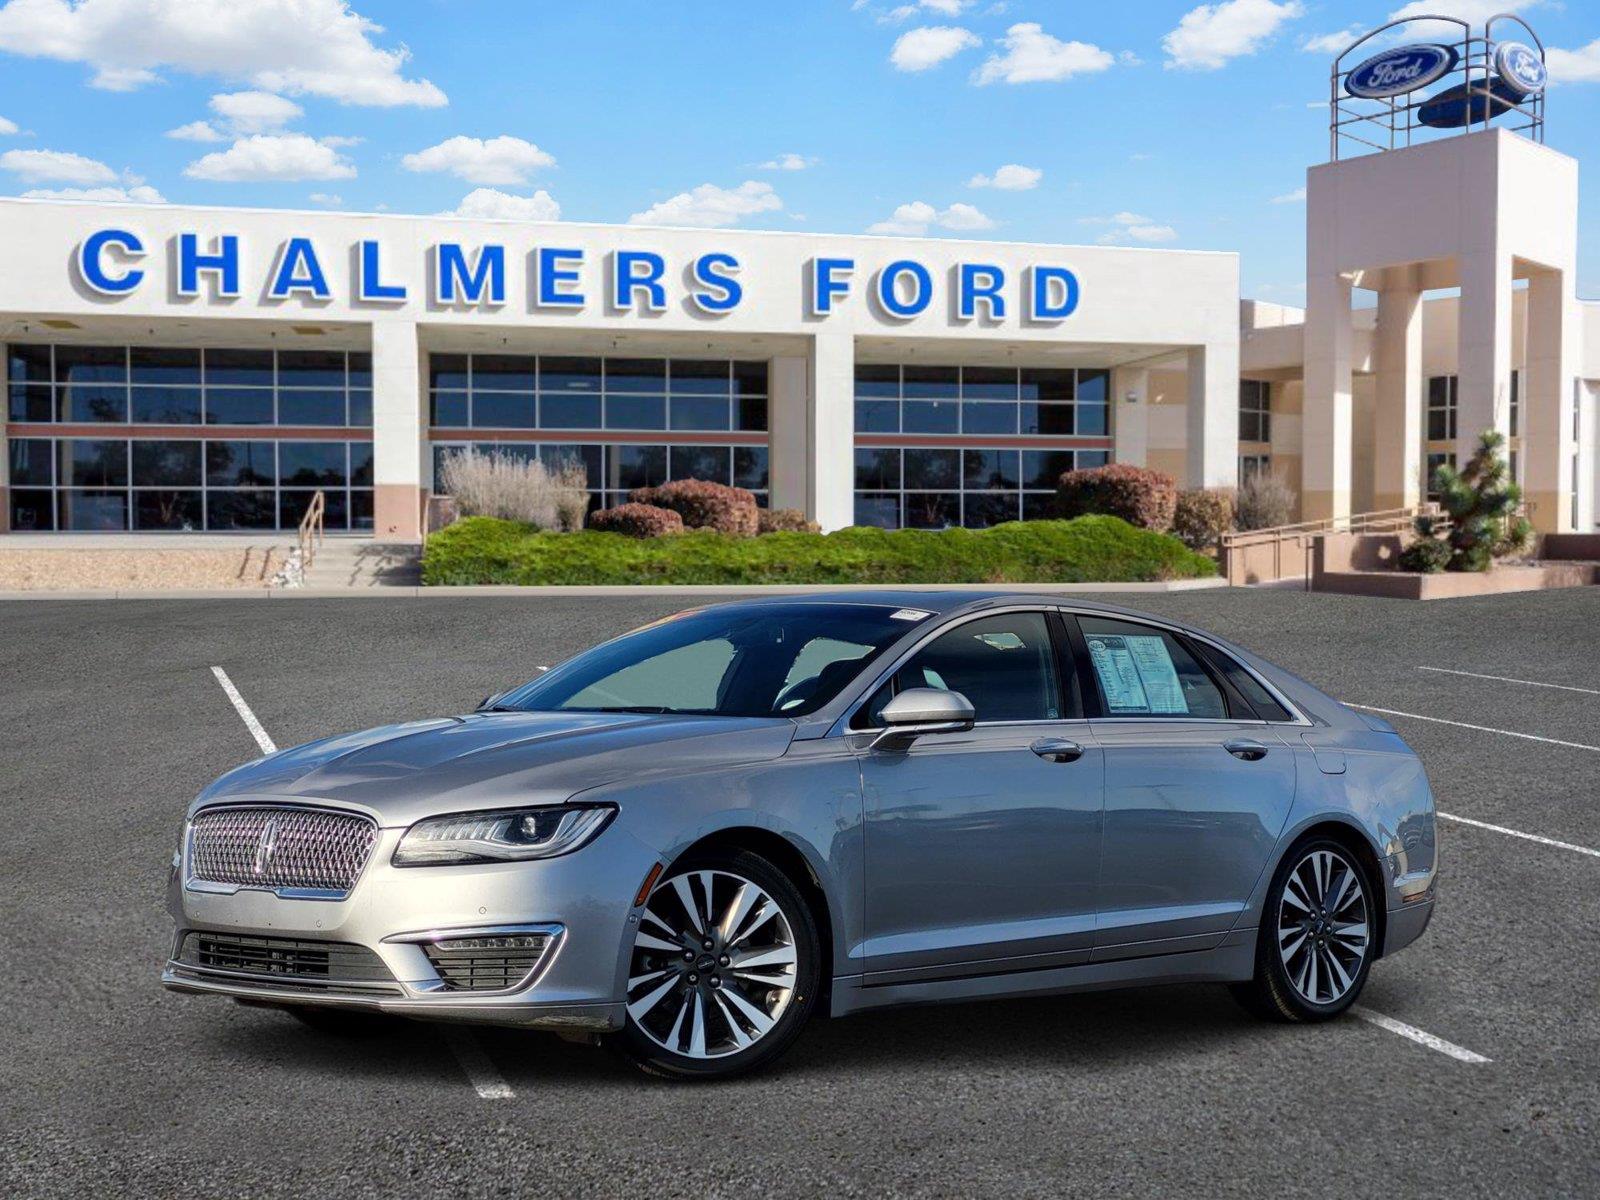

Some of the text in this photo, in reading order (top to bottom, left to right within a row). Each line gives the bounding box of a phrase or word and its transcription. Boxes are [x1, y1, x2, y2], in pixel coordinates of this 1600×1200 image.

[1367, 56, 1423, 88] Ford
[1515, 51, 1539, 81] Ford
[80, 228, 1081, 319] CHALMERS FORD
